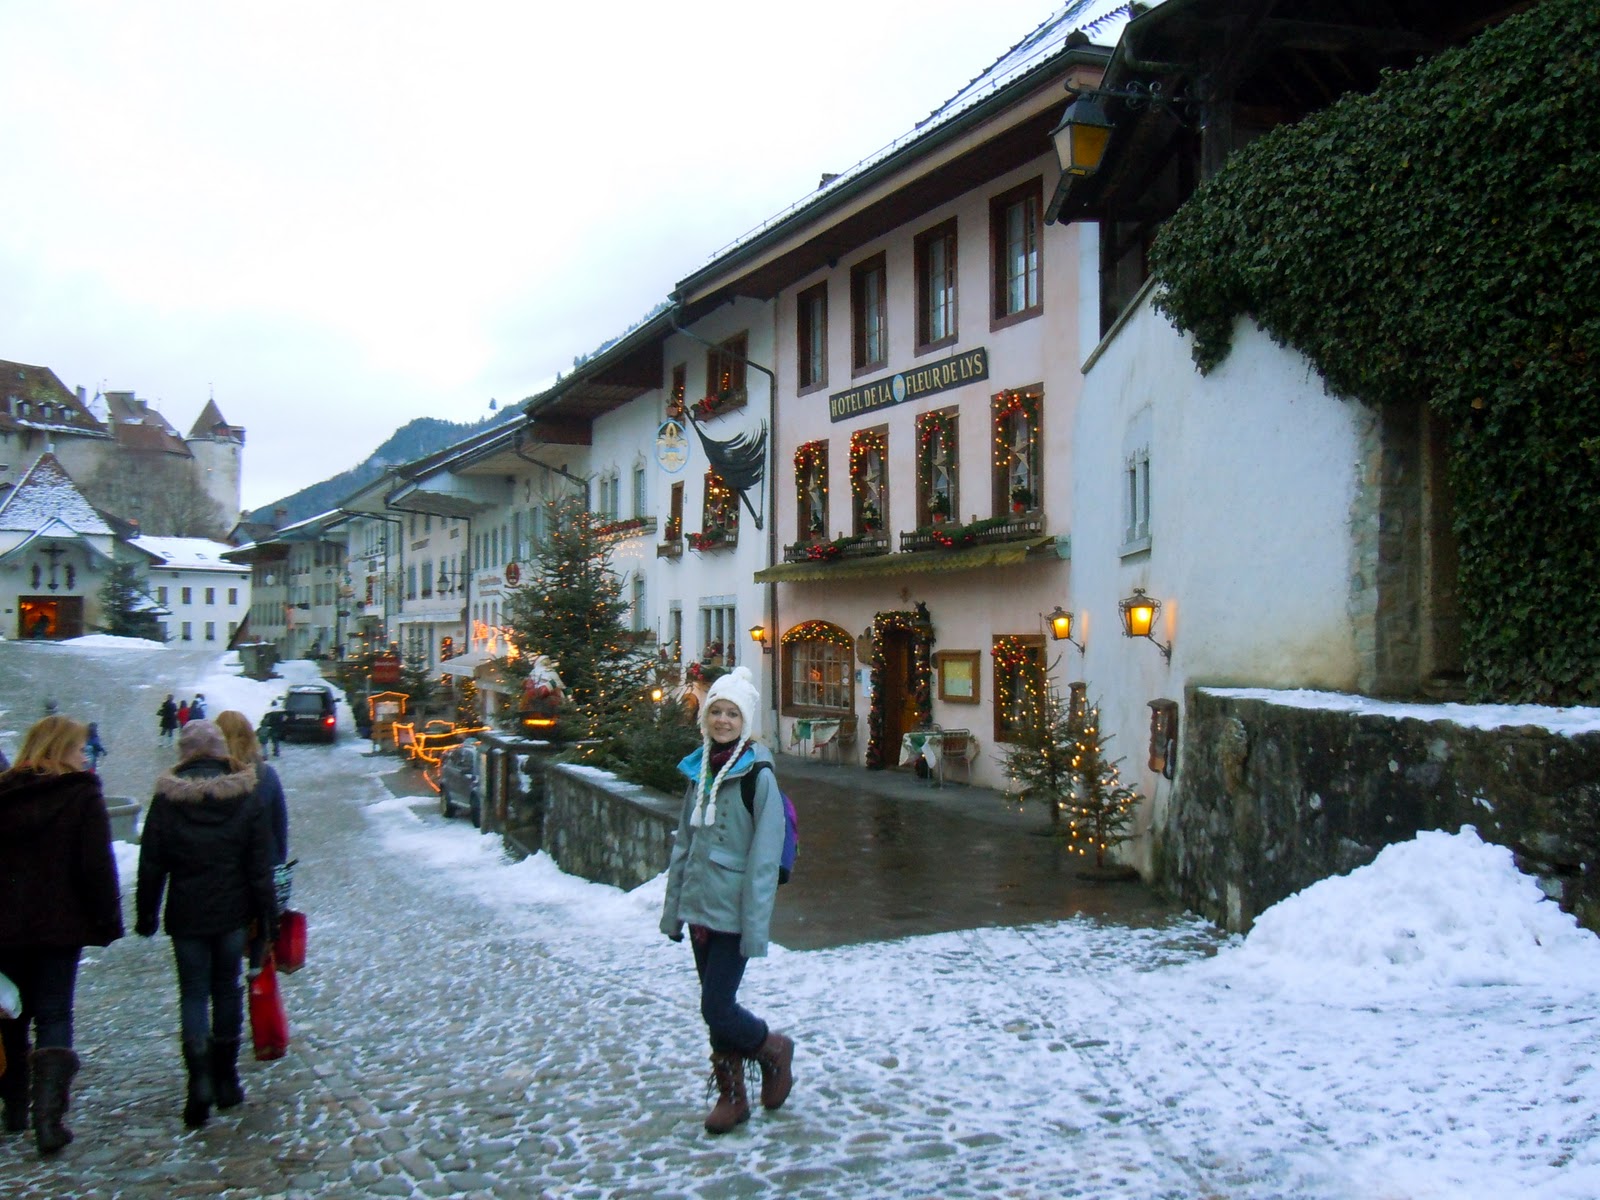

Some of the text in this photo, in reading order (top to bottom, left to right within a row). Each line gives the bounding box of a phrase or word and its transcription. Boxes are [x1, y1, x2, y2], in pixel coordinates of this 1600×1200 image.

[831, 353, 983, 416] HOTEL DE LA FLEUR DE LYS
